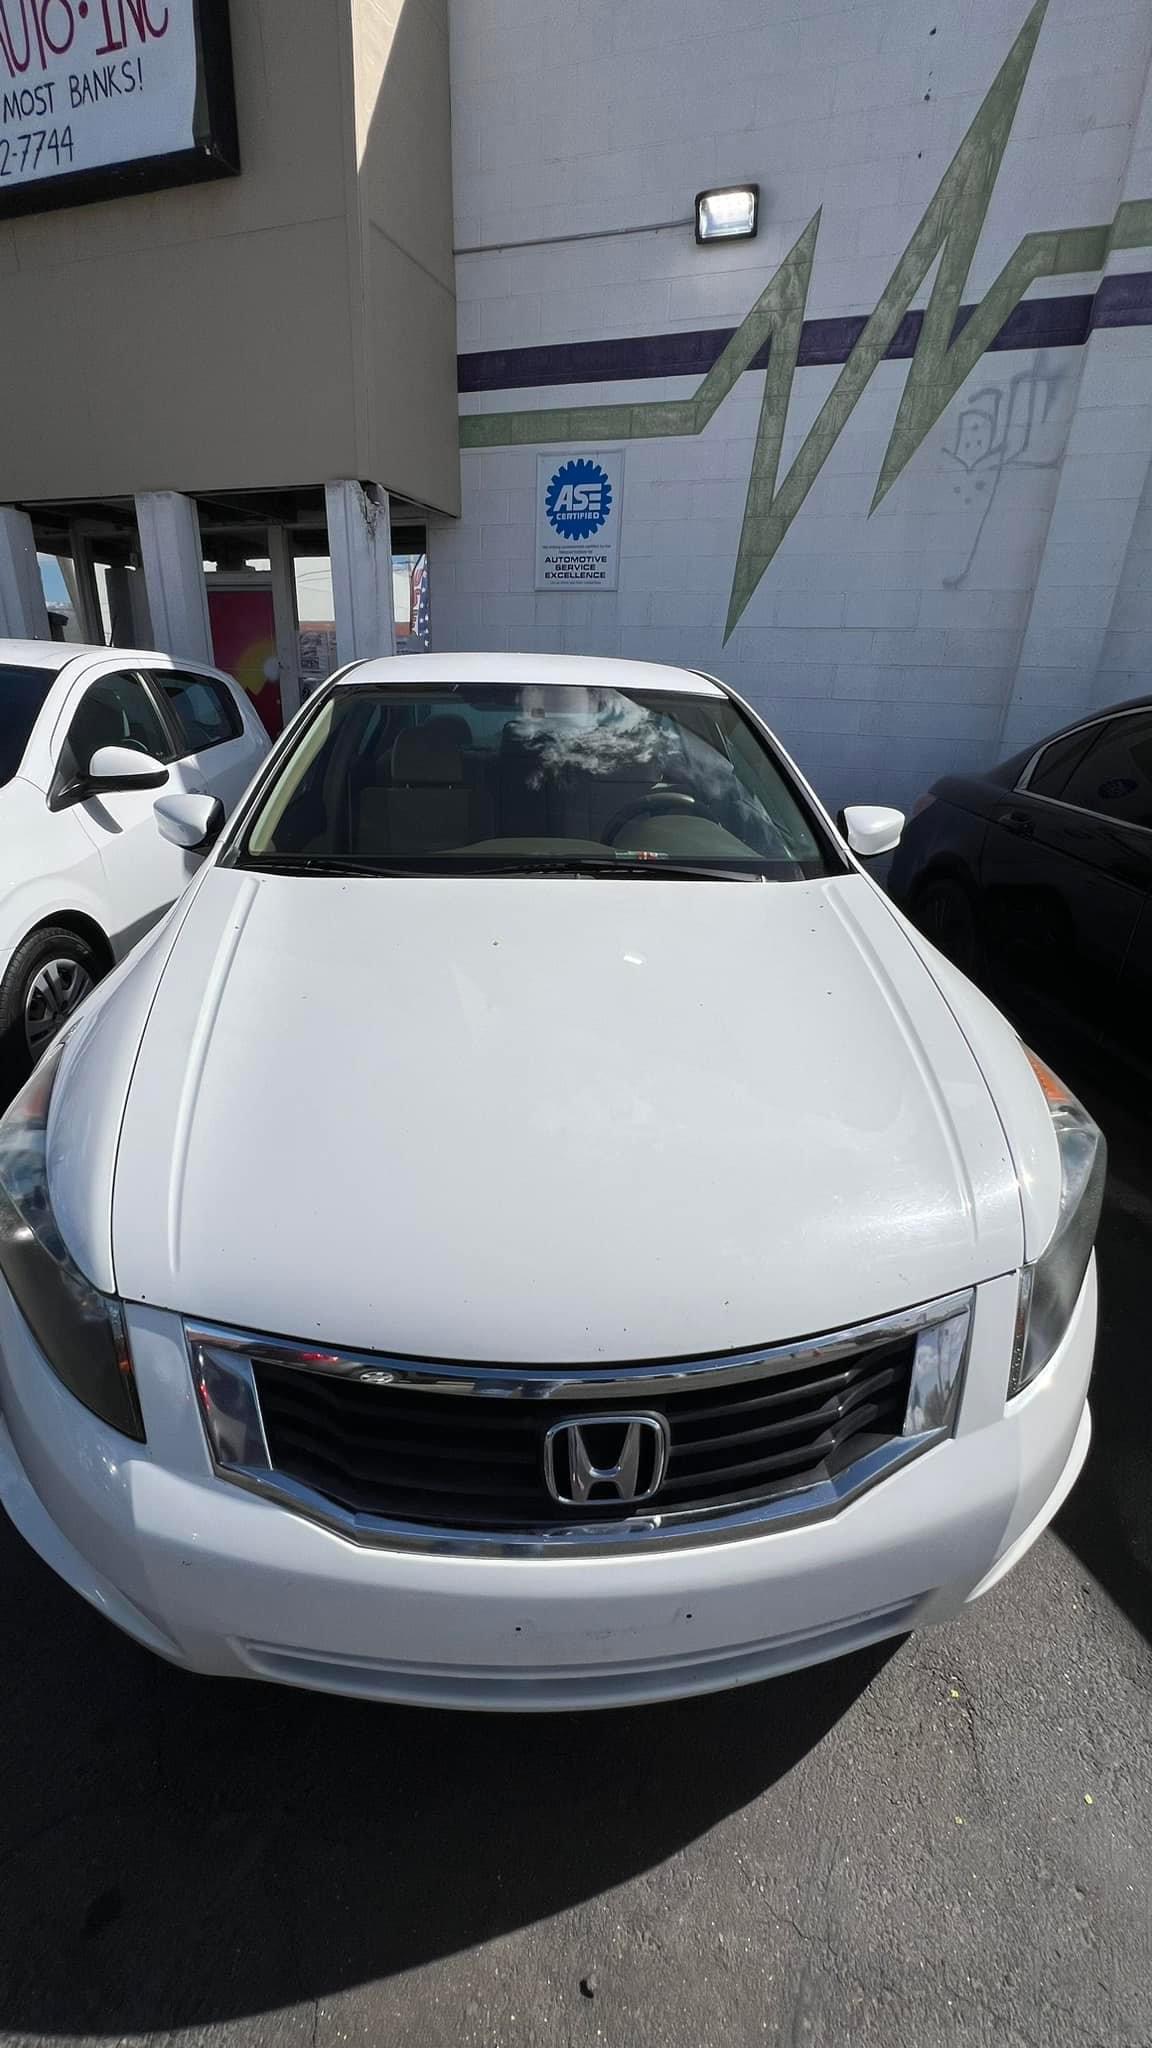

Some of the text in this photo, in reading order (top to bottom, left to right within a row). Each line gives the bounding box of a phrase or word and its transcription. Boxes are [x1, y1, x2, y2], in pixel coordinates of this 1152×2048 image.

[0, 0, 74, 77] UTO
[4, 57, 143, 124] MOST BANKS!
[553, 483, 602, 512] ASE
[556, 512, 600, 520] CERTIFIED
